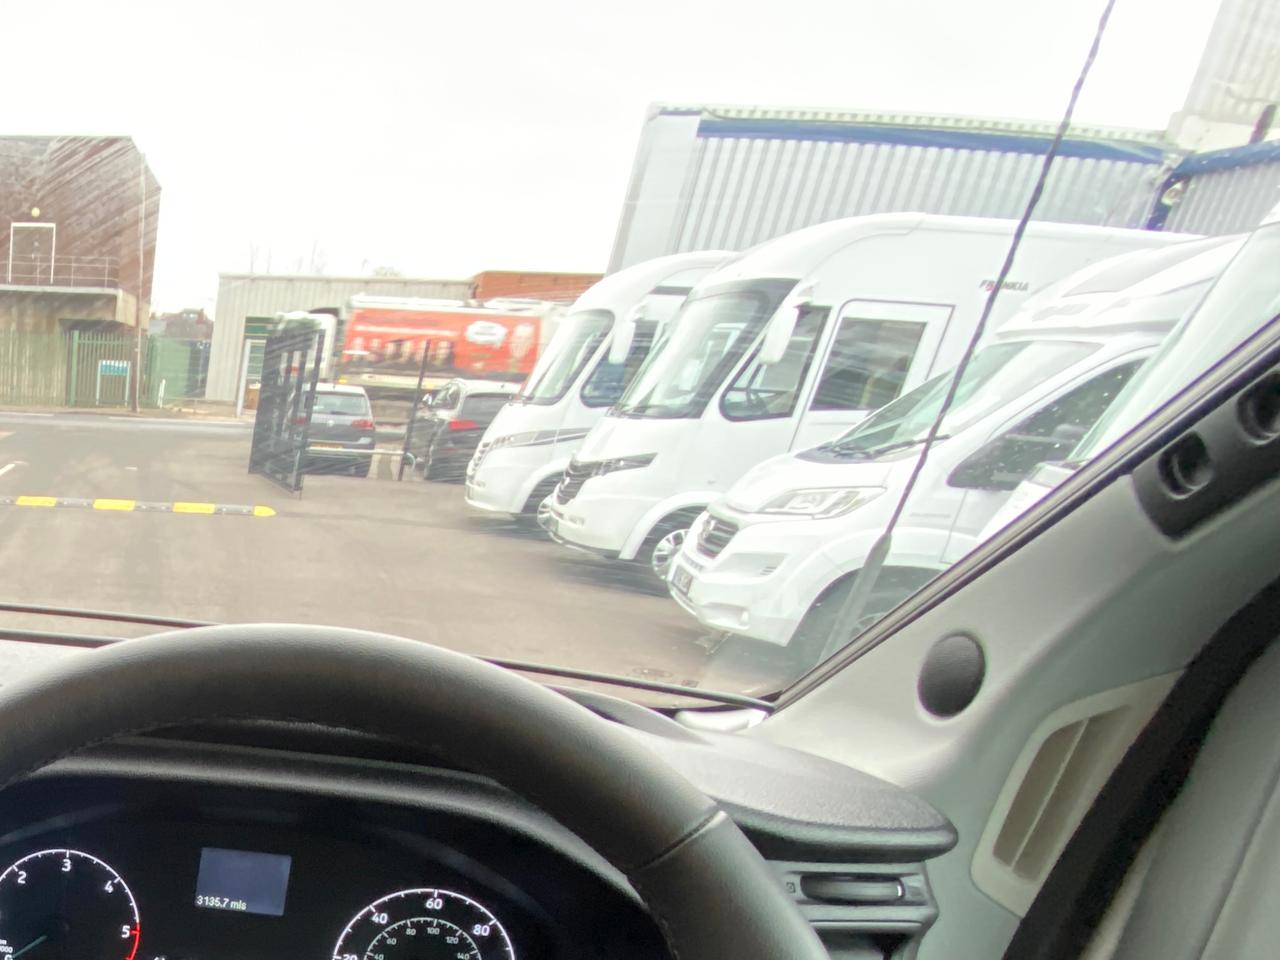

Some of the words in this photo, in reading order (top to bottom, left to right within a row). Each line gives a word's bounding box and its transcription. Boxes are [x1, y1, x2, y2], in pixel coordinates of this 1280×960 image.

[61, 858, 72, 872] 3
[17, 871, 27, 884] 2
[104, 880, 114, 893] 4
[196, 895, 230, 908] 3135.7
[230, 900, 247, 911] mls
[425, 898, 443, 910] 60
[371, 913, 388, 925] 40
[121, 925, 131, 938] 5
[406, 927, 417, 936] 80
[426, 927, 440, 935] 100
[472, 924, 490, 937] 80
[386, 937, 397, 945] 60
[445, 936, 459, 944] 120
[373, 953, 384, 960] 40
